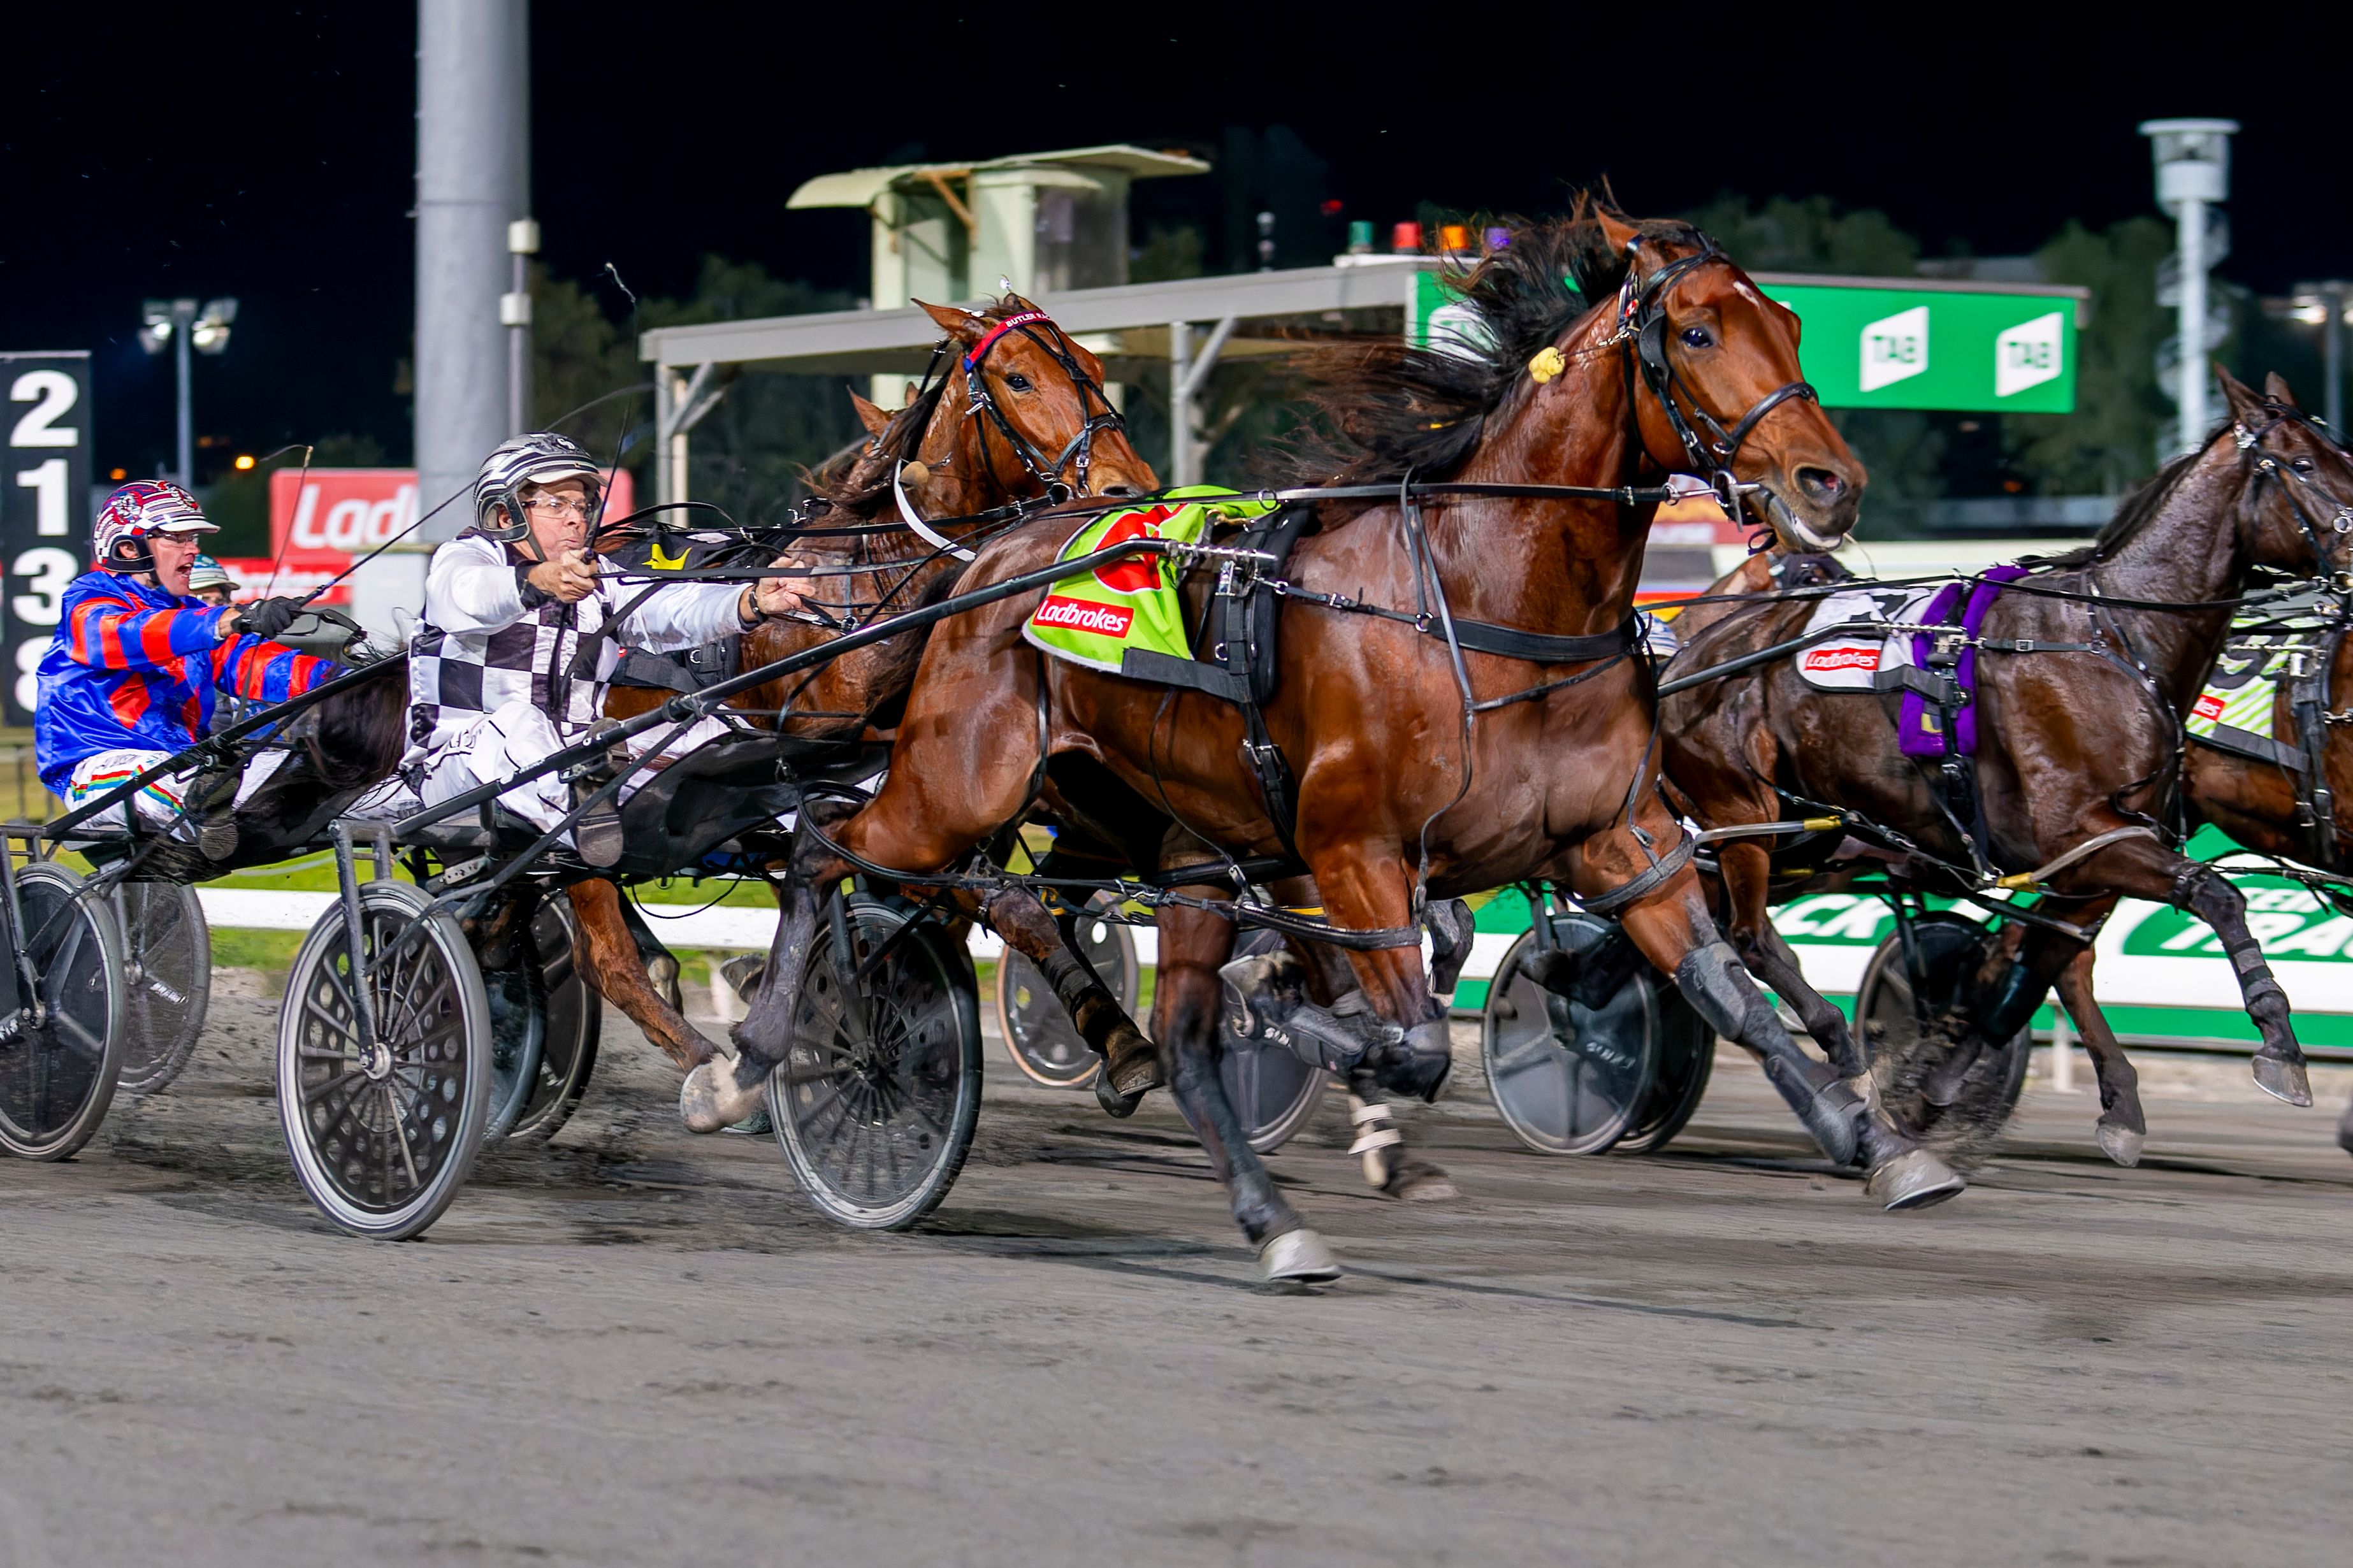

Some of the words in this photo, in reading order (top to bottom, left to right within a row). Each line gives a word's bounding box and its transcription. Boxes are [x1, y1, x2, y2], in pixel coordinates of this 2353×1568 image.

[1005, 313, 1036, 327] BUTLER
[1869, 335, 1916, 364] TAB
[2006, 342, 2050, 370] TAB
[10, 370, 78, 446] 2
[17, 458, 69, 536] 1
[12, 547, 78, 626] 3
[1036, 600, 1128, 632] Ladbrokes
[1806, 652, 1878, 668] Ladbrokes
[2159, 912, 2353, 958] TRA
